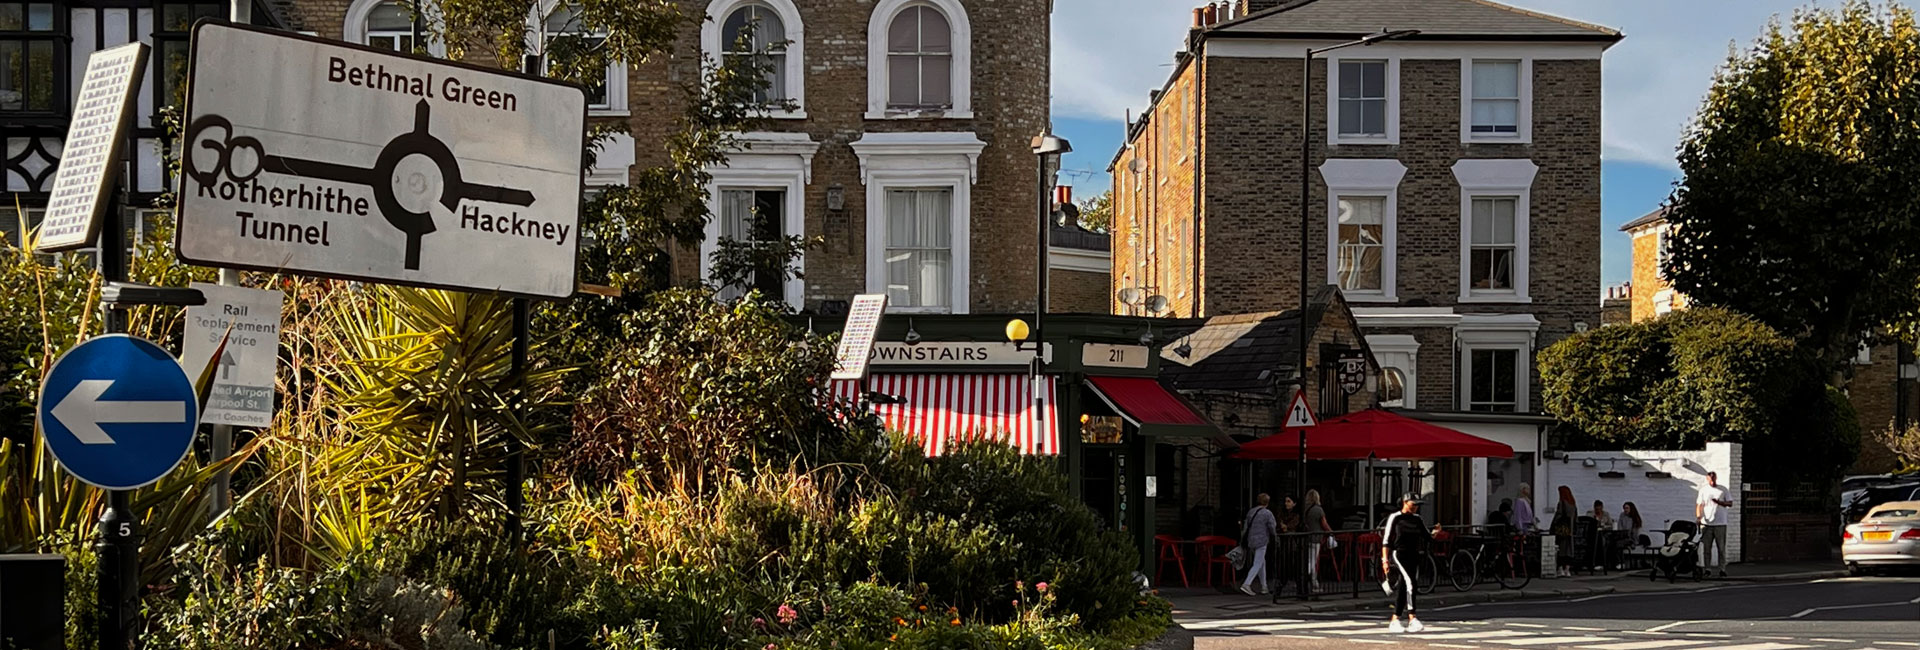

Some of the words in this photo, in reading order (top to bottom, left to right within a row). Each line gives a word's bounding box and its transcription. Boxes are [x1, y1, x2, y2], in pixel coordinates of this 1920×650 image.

[328, 56, 433, 98] Bethnal
[441, 77, 518, 111] Green
[199, 174, 370, 216] Rotherhithe
[235, 211, 331, 247] Tunnel
[460, 205, 570, 244] Hackney
[223, 303, 249, 317] Rail
[208, 331, 257, 347] Sevice
[1109, 349, 1124, 362] 211
[234, 386, 271, 399] Airport
[223, 412, 265, 424] Coaches
[118, 522, 131, 537] 5
